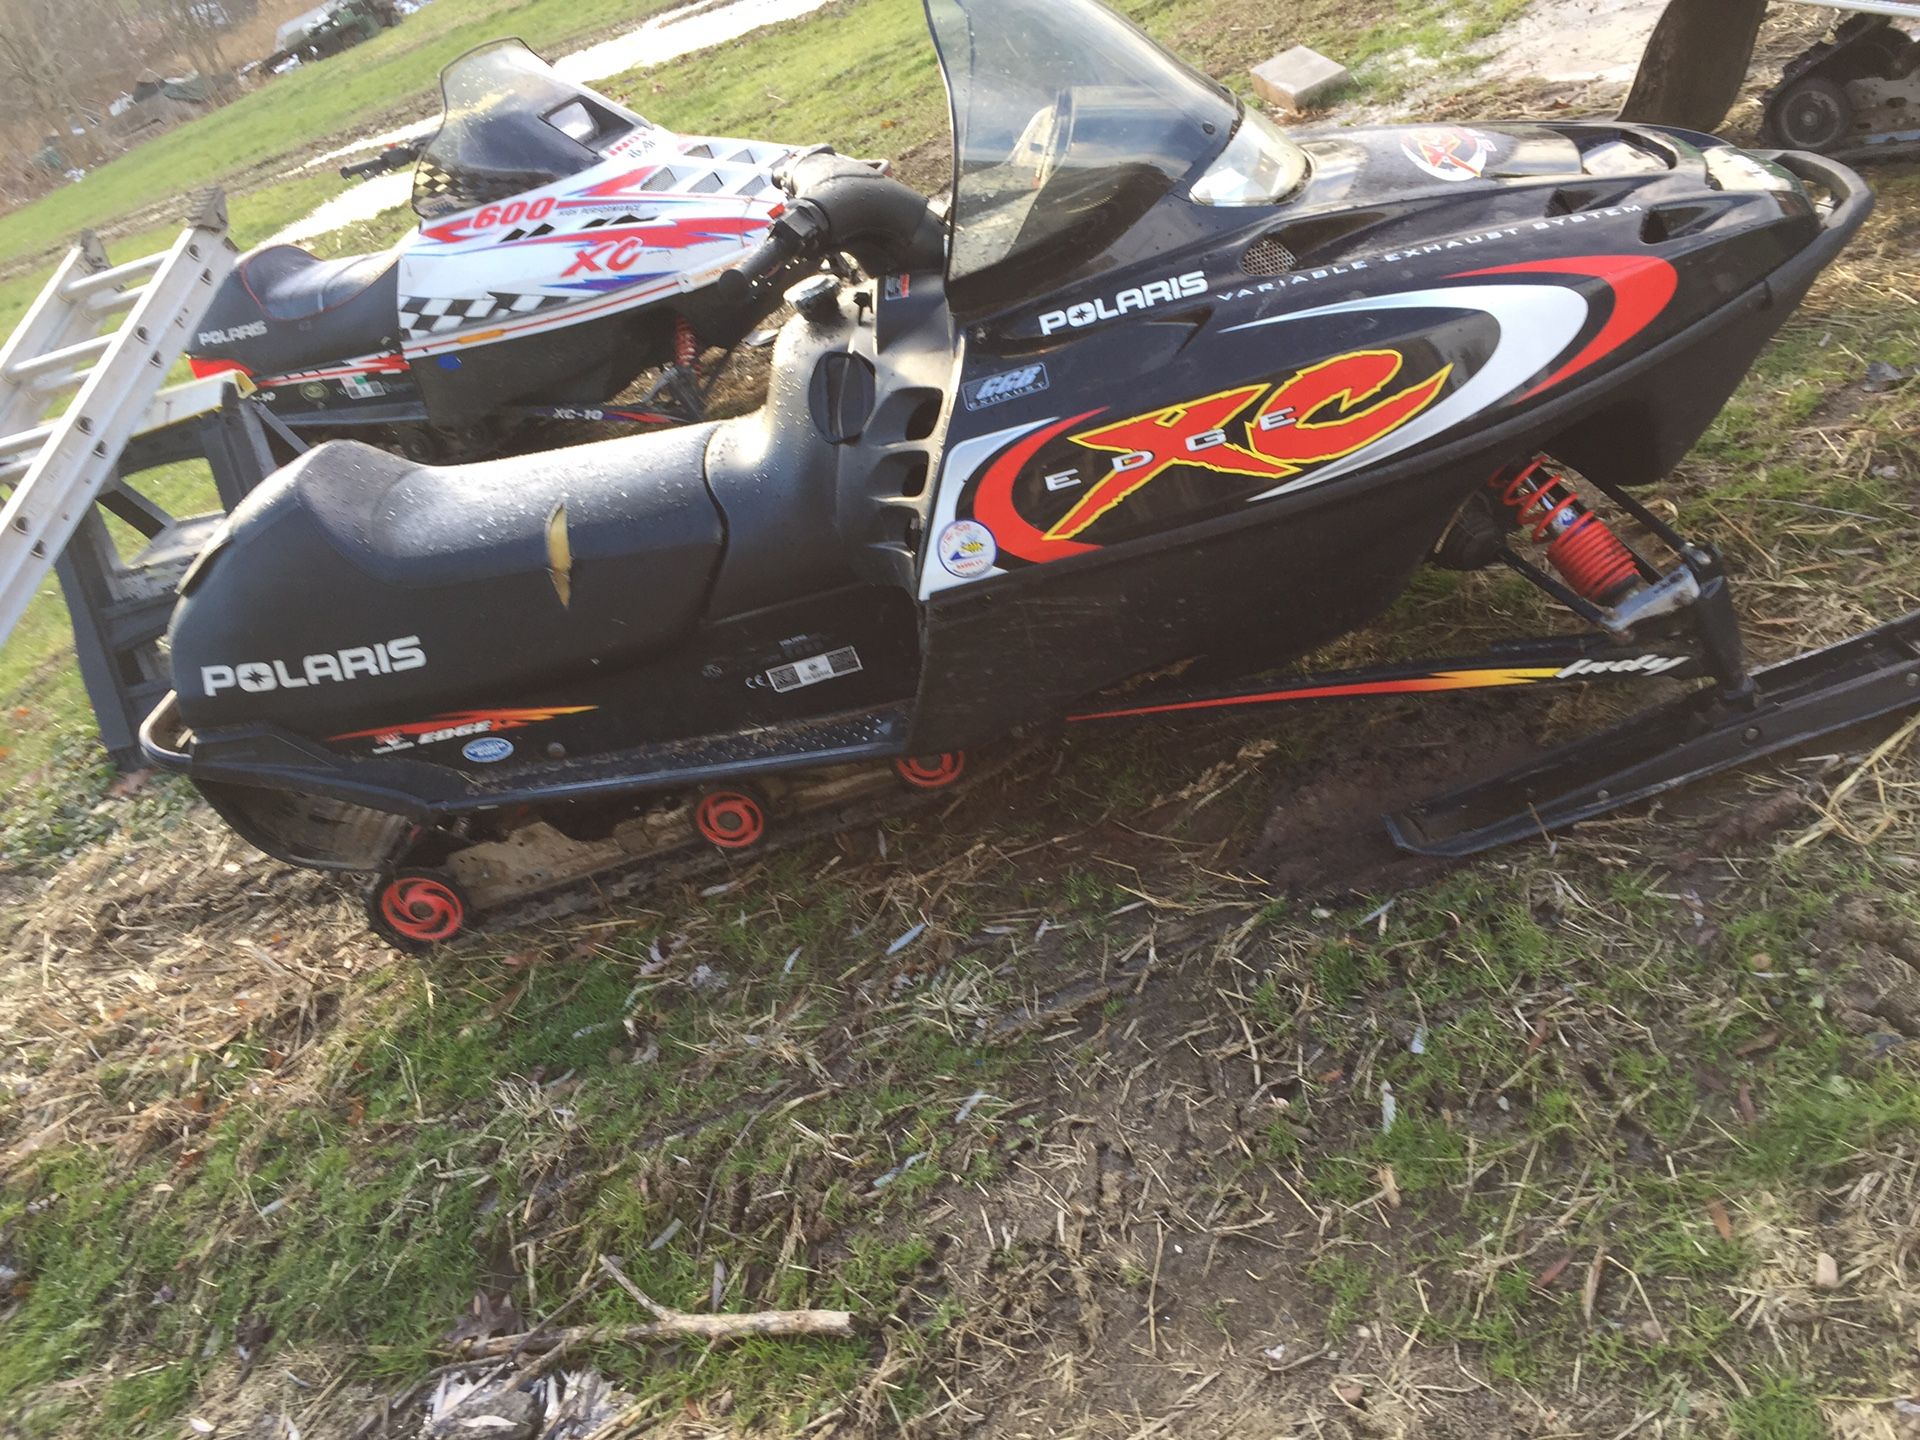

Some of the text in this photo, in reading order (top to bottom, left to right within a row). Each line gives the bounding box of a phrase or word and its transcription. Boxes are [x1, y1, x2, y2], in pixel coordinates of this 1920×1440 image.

[473, 197, 556, 229] 600
[560, 237, 643, 277] XC
[1216, 204, 1642, 301] VARIABLE EXHAUST SYSTEM
[1038, 270, 1208, 335] POLARIS
[199, 320, 268, 346] POLARIS
[553, 408, 604, 420] XC-10
[1042, 349, 1454, 541] XC
[1044, 405, 1300, 491] EDGE
[200, 635, 428, 697] POLARIS
[417, 720, 493, 745] EDGE
